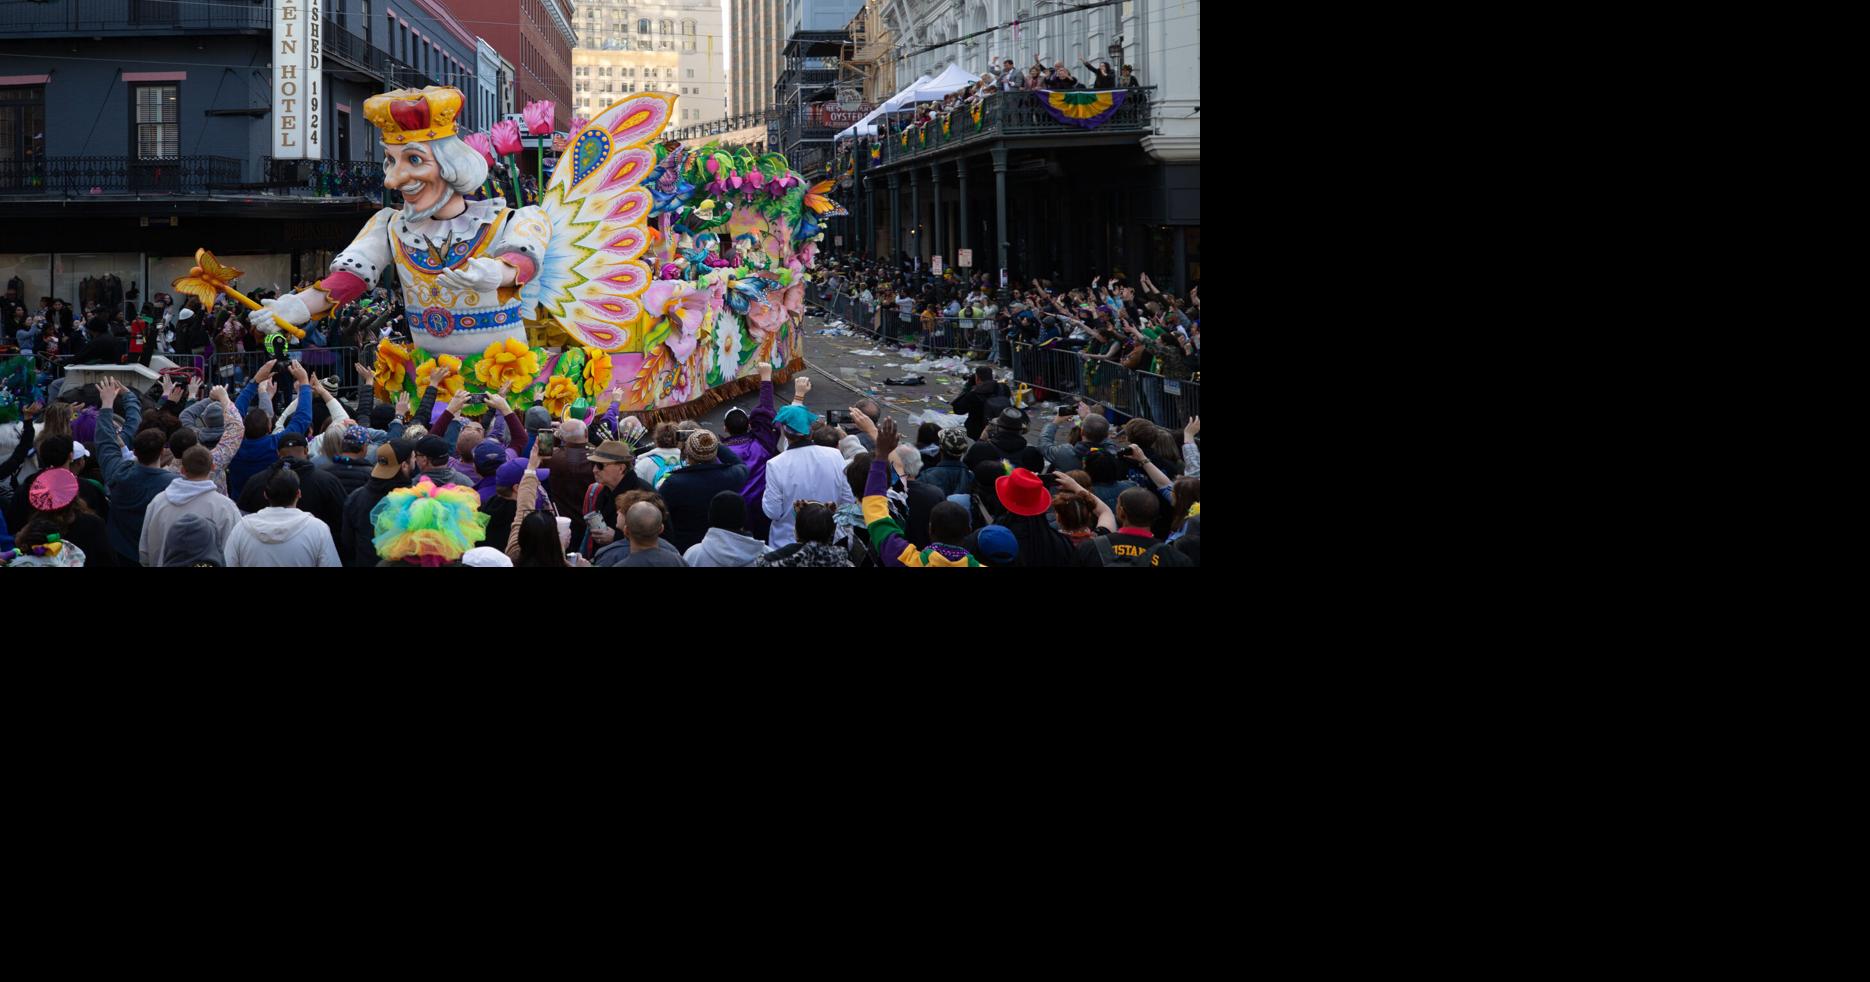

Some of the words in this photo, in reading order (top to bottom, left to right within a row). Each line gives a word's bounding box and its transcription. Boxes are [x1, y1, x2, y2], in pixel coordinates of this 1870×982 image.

[281, 0, 297, 54] EIN
[281, 65, 297, 147] HOTEL
[310, 81, 319, 144] 1924
